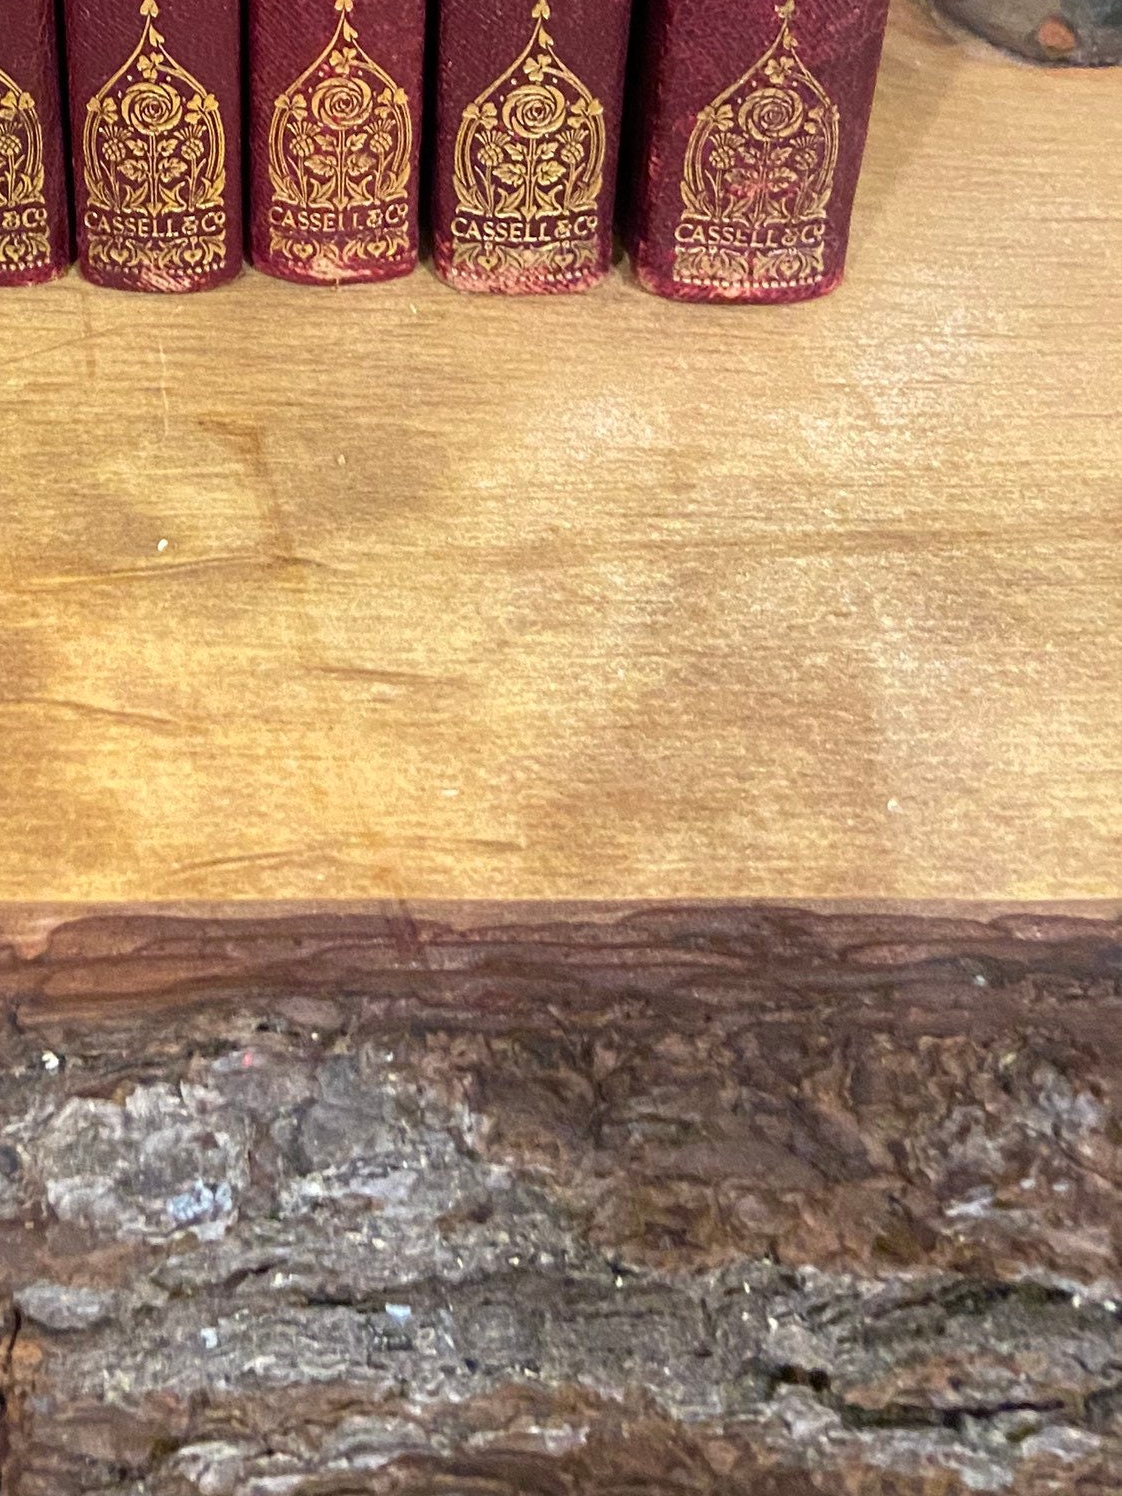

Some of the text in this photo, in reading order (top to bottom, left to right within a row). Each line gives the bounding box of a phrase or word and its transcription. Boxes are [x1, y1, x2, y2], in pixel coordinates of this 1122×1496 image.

[2, 209, 20, 229] &
[84, 212, 175, 237] CASSELL
[181, 215, 198, 235] &
[268, 206, 364, 231] CASSELL
[366, 209, 382, 228] &
[450, 218, 551, 242] CASSELL
[554, 219, 573, 239] &
[674, 223, 777, 248] CASSELL
[781, 226, 800, 245] &
